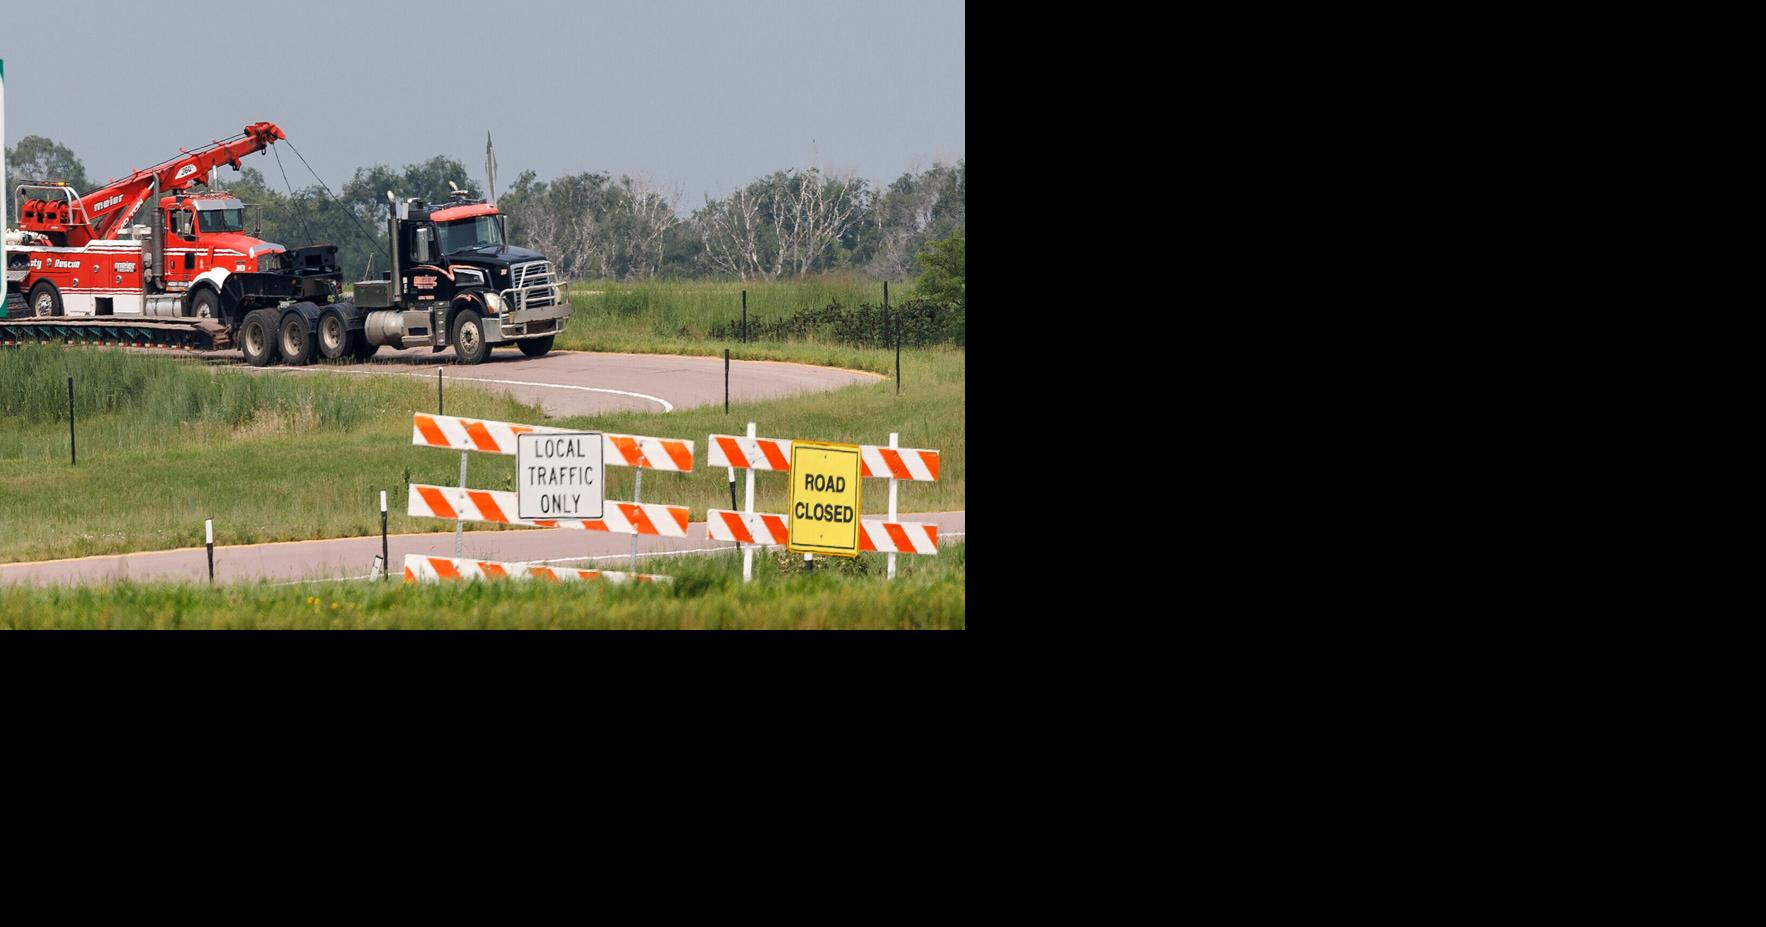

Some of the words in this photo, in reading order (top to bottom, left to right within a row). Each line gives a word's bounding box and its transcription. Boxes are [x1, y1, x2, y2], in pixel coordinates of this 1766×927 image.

[535, 439, 585, 458] LOCAL
[528, 466, 593, 486] TRAFFIC
[804, 473, 846, 493] ROAD
[540, 494, 581, 514] ONLY
[795, 501, 854, 523] CLOSED
